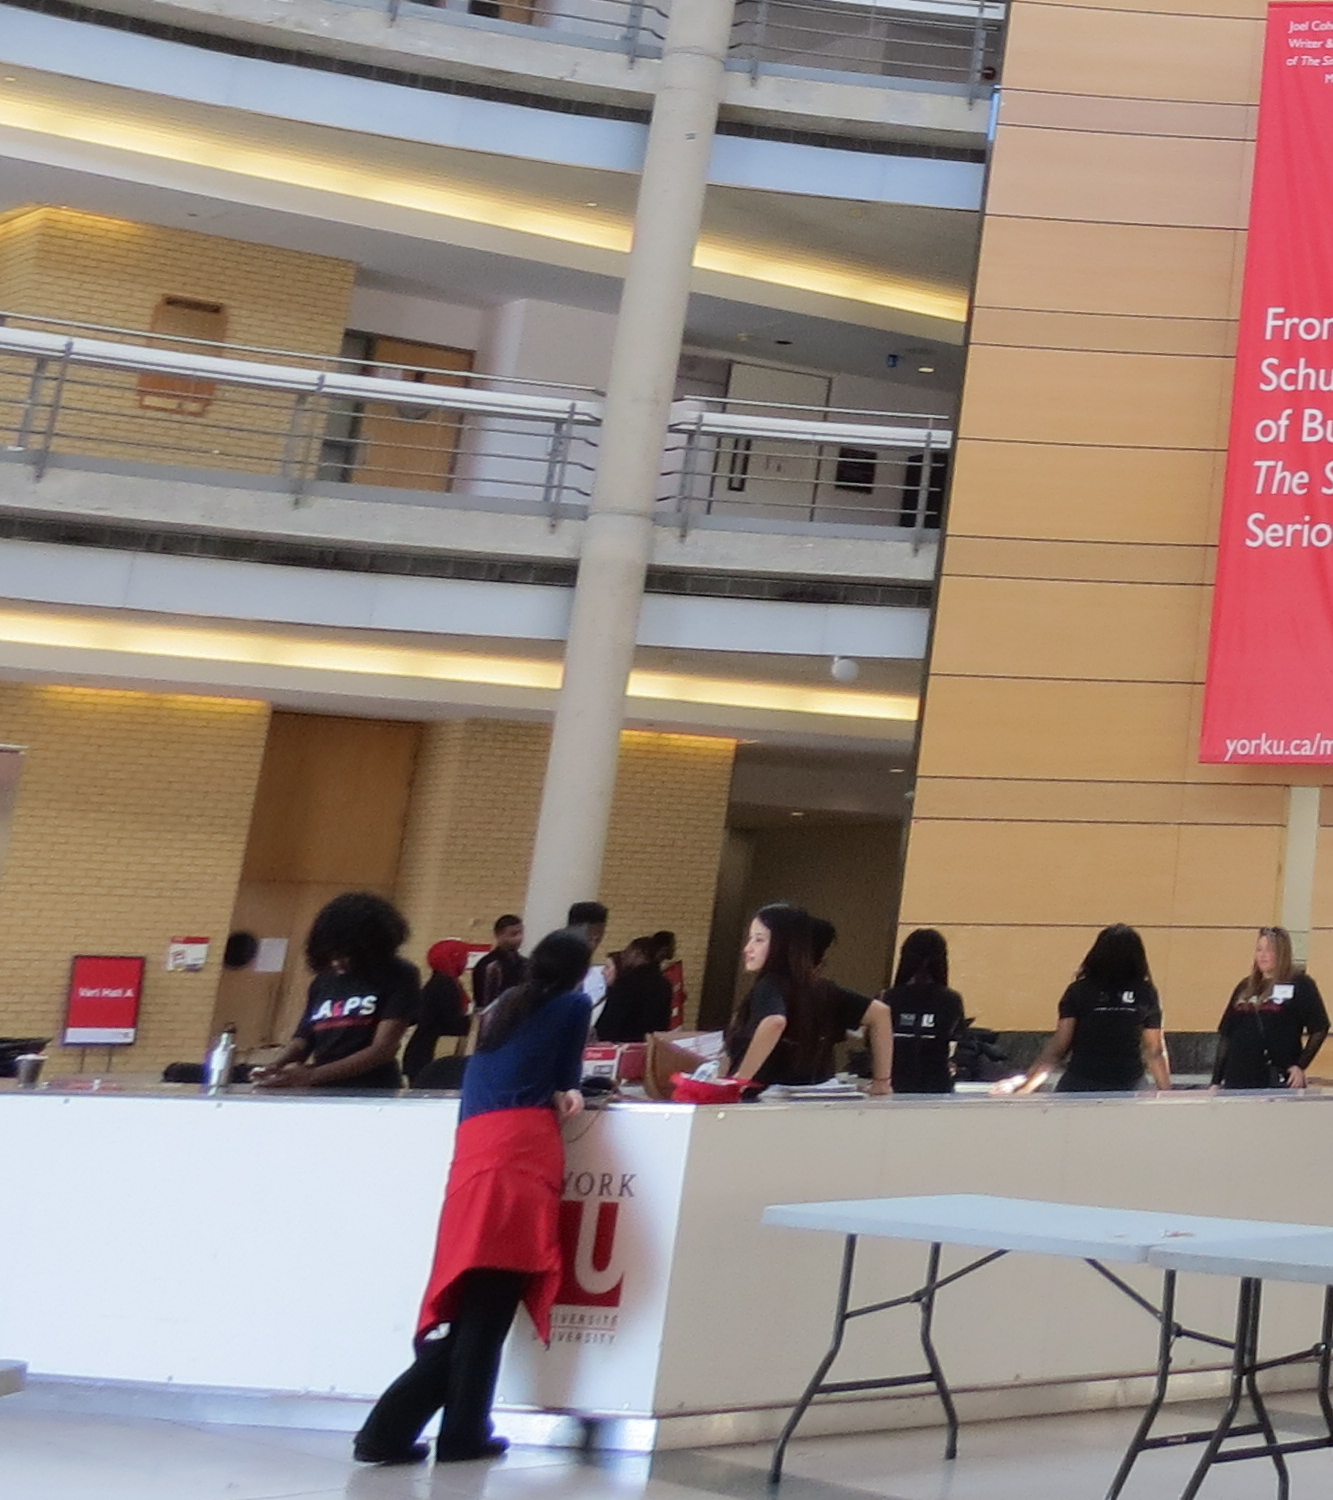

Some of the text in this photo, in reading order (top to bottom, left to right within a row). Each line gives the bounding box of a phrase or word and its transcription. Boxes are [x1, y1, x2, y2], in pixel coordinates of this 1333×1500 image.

[1288, 21, 1309, 34] Joel
[1288, 39, 1323, 48] Writer
[1325, 38, 1333, 48] &
[1286, 56, 1298, 66] of
[1300, 56, 1320, 66] The
[1255, 410, 1295, 445] of
[1252, 461, 1310, 495] The
[102, 987, 123, 997] Hall
[125, 988, 134, 997] A
